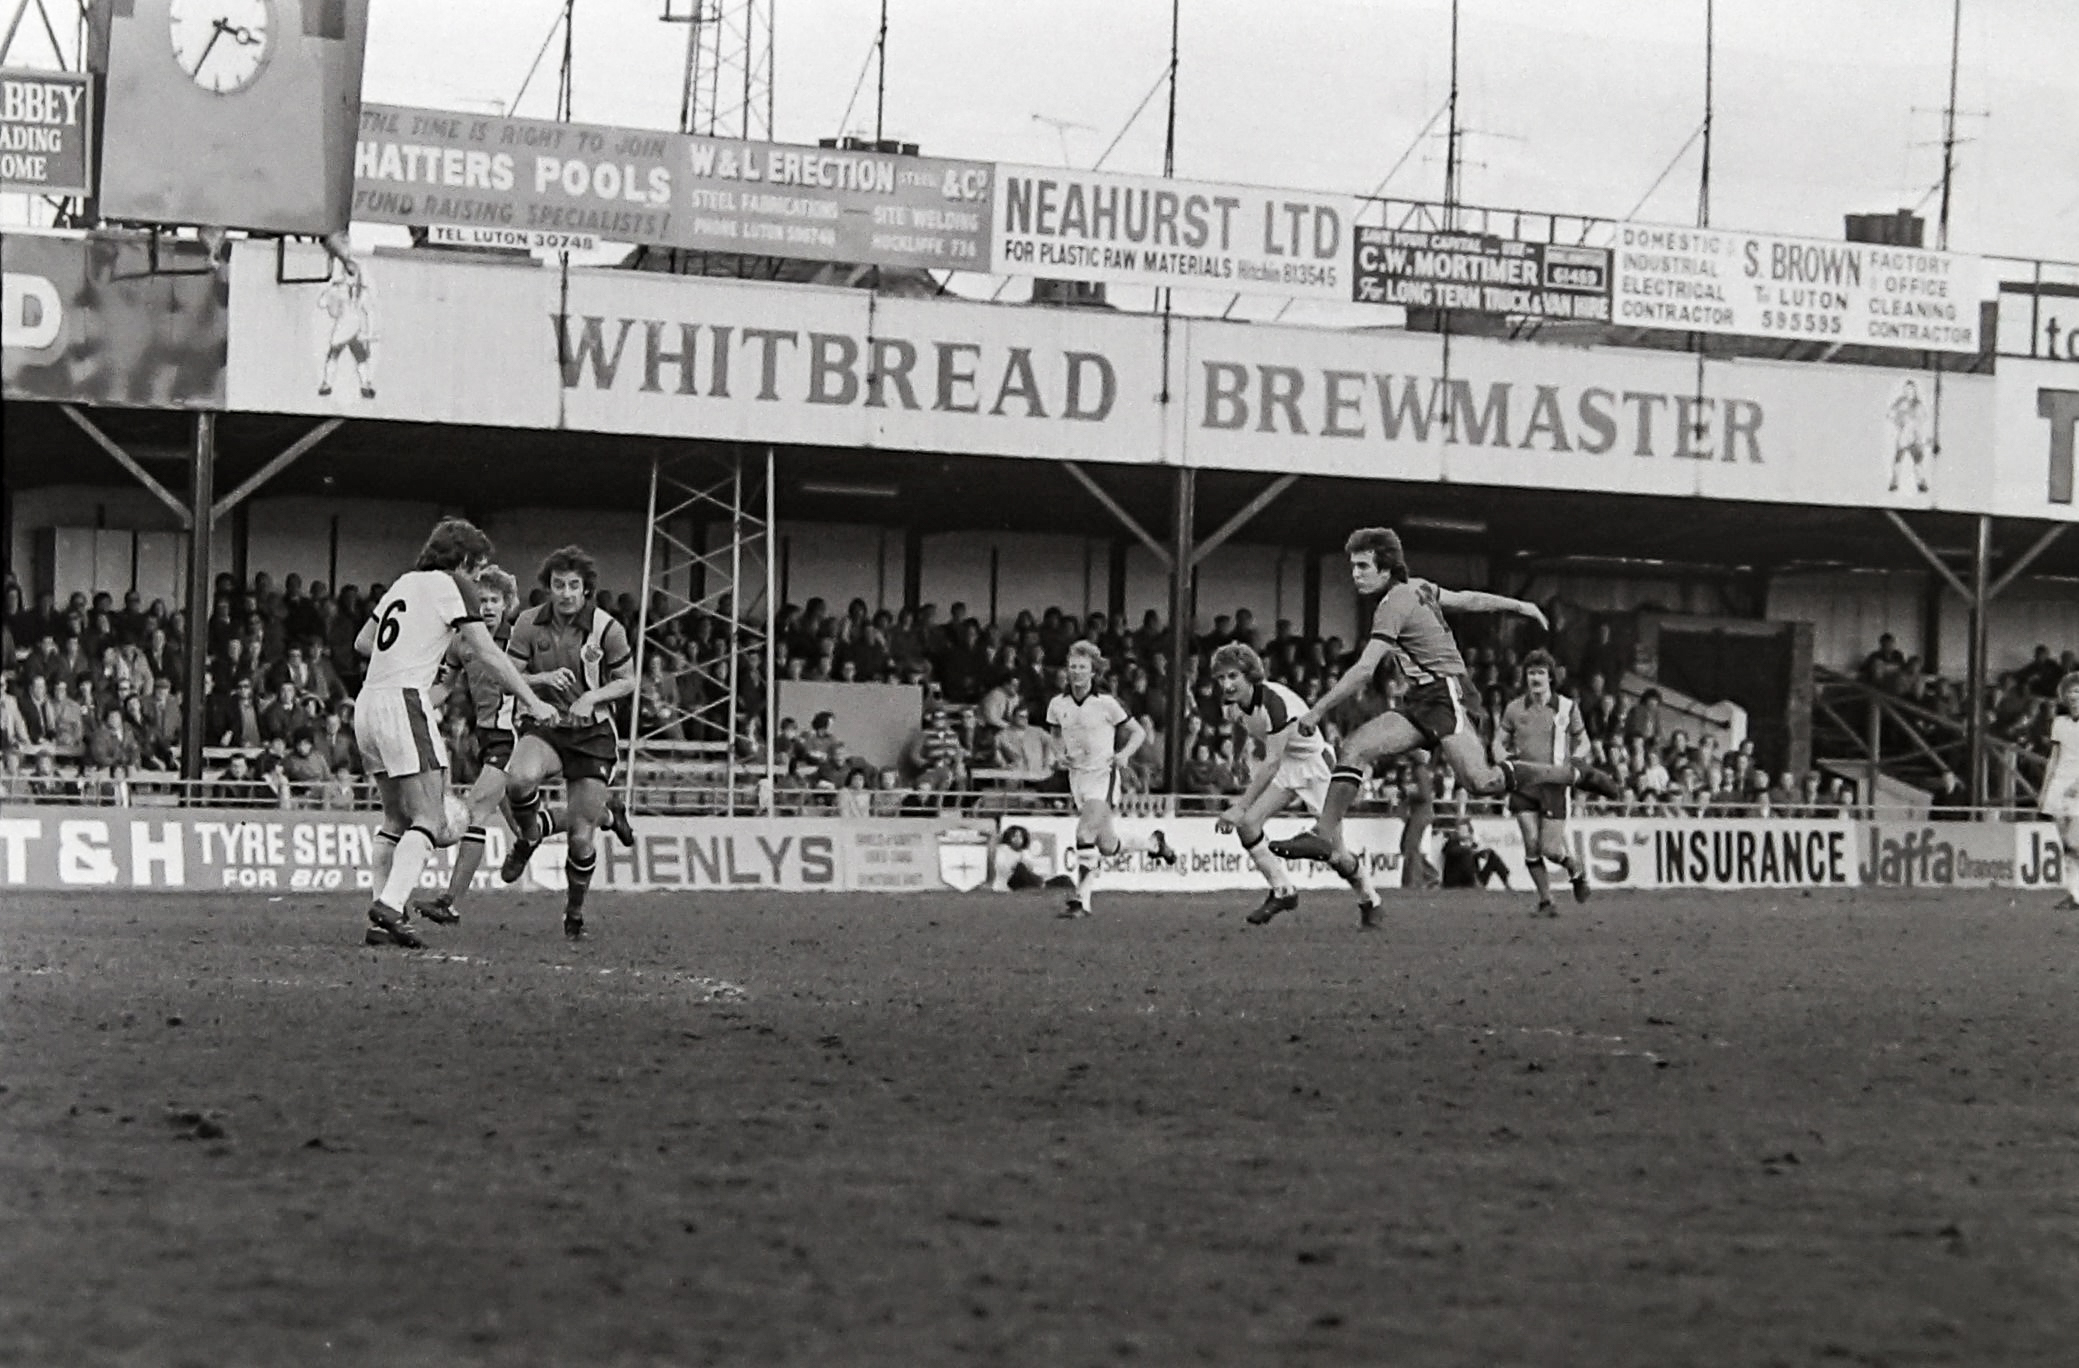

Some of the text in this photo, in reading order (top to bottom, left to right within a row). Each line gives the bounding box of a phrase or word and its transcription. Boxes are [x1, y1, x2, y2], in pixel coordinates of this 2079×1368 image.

[0, 81, 84, 126] BBEY
[354, 141, 672, 204] HATTERS POOLS
[768, 151, 897, 193] ERECTION
[354, 189, 413, 214] FUND
[424, 194, 513, 223] RAISING
[874, 206, 905, 226] SITE
[1005, 177, 1341, 260] NEAHURST LTD
[474, 229, 528, 246] LUTON
[534, 234, 593, 250] 30748
[1623, 227, 1720, 255] DOMESTIC
[1004, 240, 1034, 263] FOR
[1040, 243, 1100, 268] PLASTIC
[1104, 248, 1137, 270] RAW
[1144, 251, 1232, 279] MATERIALS
[1623, 253, 1720, 279] INDUSTRIAL
[1771, 243, 1862, 288] BROWN
[1869, 250, 1952, 276] FACTORY
[1385, 278, 1434, 306] LONG
[1434, 283, 1481, 310] TERM
[1621, 275, 1726, 303] ELECTRICAL
[1779, 286, 1848, 312] LUTON
[1884, 274, 1949, 299] OFFICE
[1621, 299, 1734, 326] CONTRACTOR
[1868, 296, 1958, 322] CLEANING
[1867, 320, 1974, 345] CONTRACTOR
[550, 312, 1765, 464] WHITBREAD BREWMASTER
[377, 598, 407, 652] 6
[194, 823, 286, 865] TYRE
[605, 836, 834, 884] HENLYS
[1191, 847, 1242, 872] better
[1655, 830, 1847, 884] INSURANCE
[1858, 826, 1953, 888] Jaffa
[2020, 830, 2063, 885] Ja
[223, 868, 278, 888] FOR
[290, 868, 342, 888] BIG
